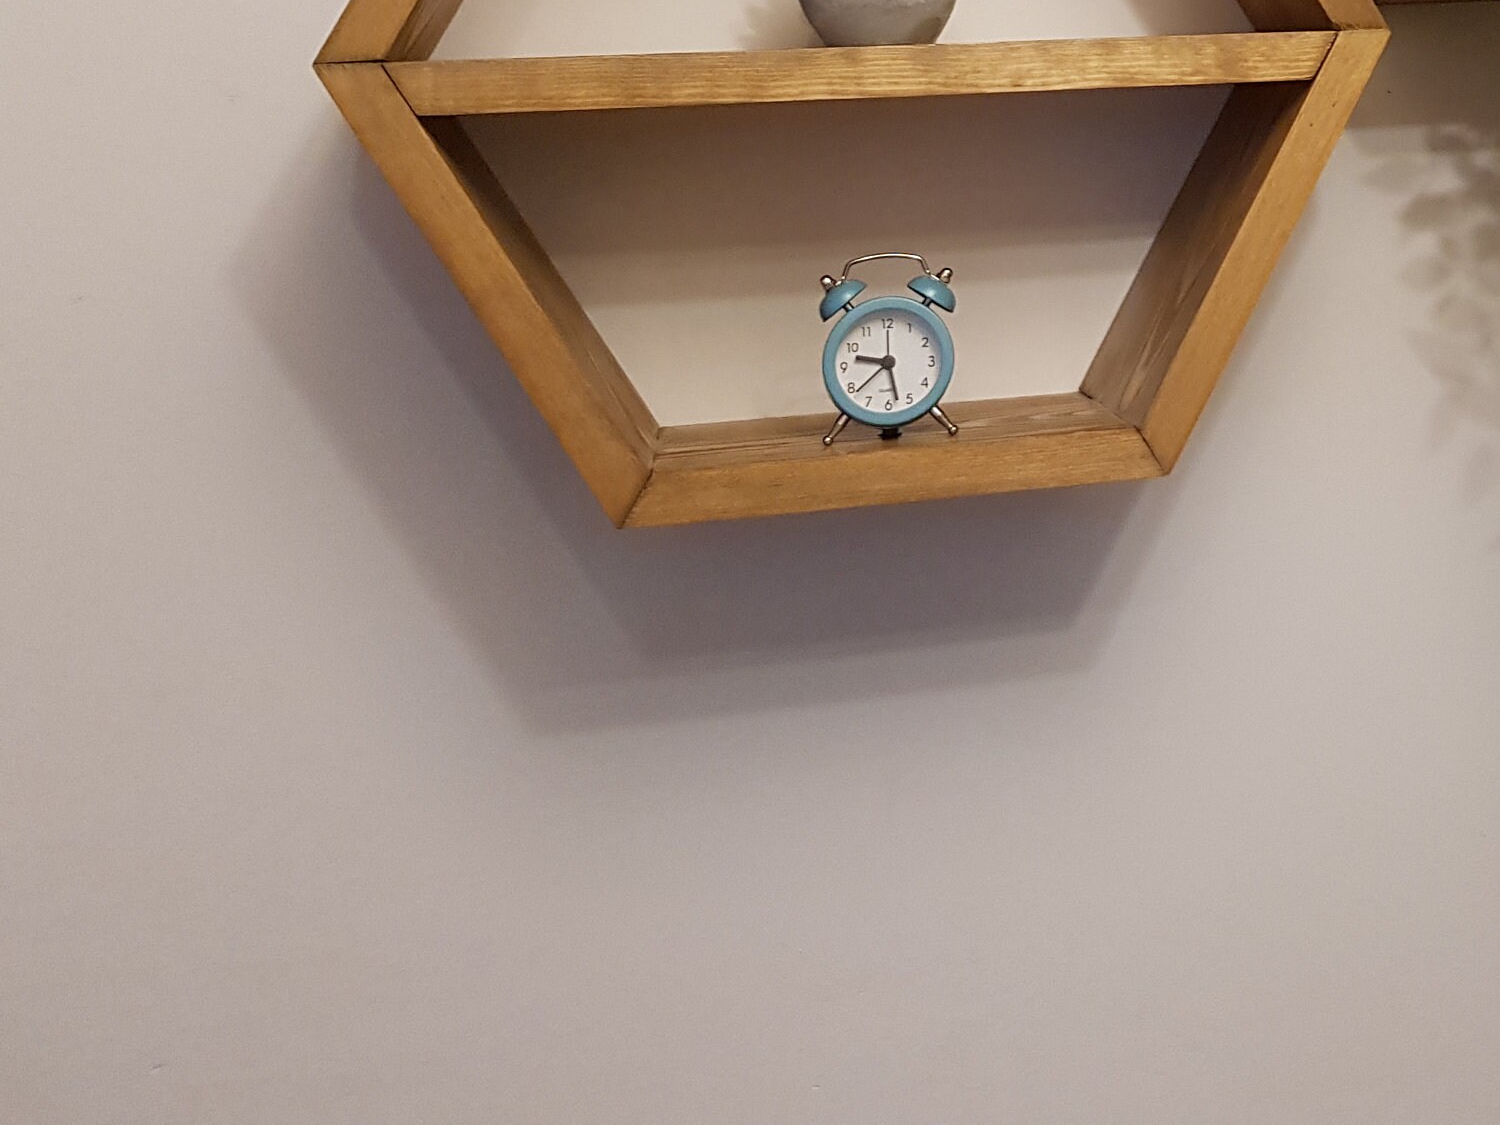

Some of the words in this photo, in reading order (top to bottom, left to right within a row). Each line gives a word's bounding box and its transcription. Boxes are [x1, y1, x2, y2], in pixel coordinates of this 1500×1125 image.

[881, 318, 894, 329] 12
[907, 323, 912, 333] 1
[861, 327, 871, 337] 11
[846, 342, 859, 353] 10
[921, 337, 929, 348] 2
[928, 355, 935, 367] 3
[839, 361, 847, 373] 9
[847, 382, 856, 394] 8
[920, 377, 929, 388] 4
[865, 396, 872, 408] 7
[906, 393, 913, 404] 5
[884, 399, 892, 411] 6
